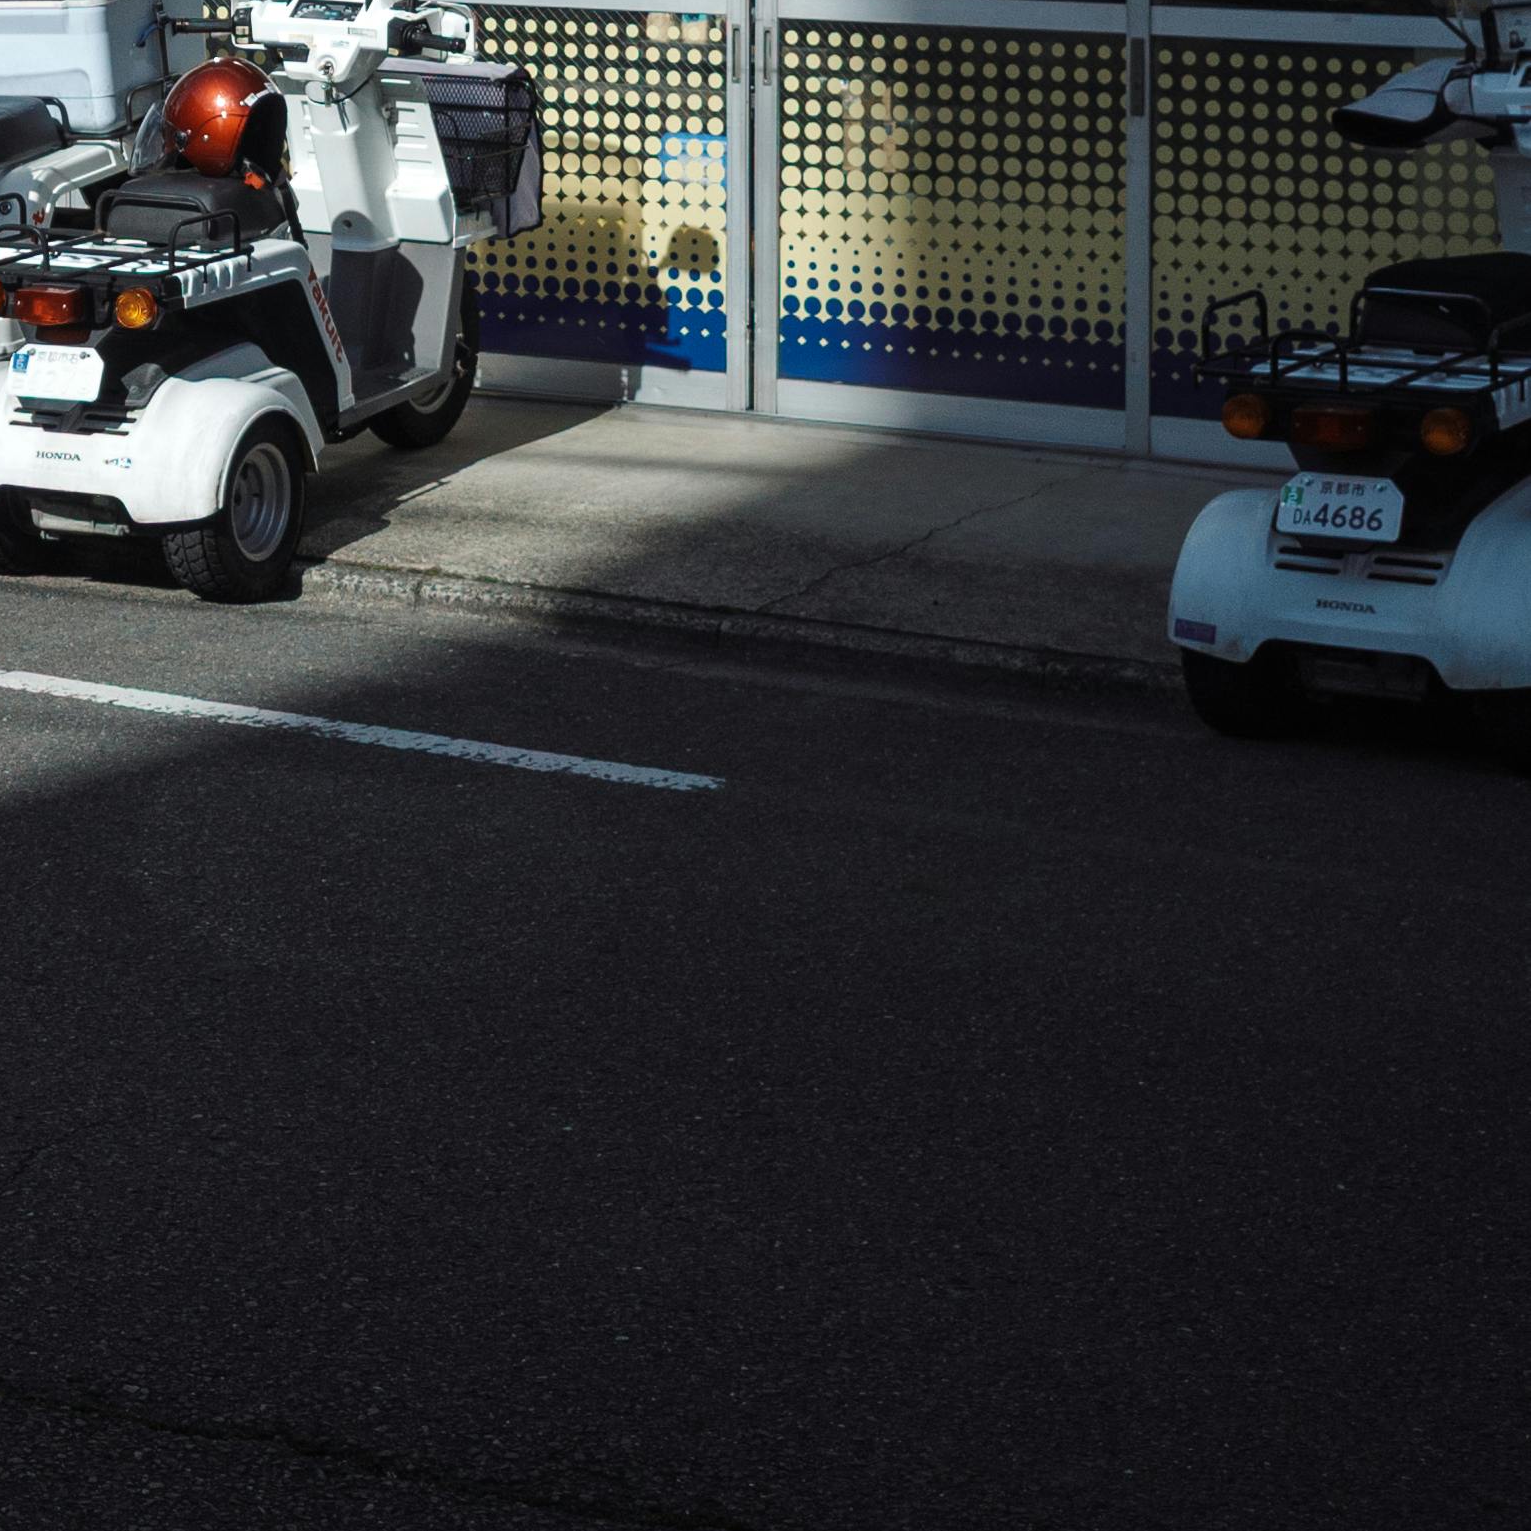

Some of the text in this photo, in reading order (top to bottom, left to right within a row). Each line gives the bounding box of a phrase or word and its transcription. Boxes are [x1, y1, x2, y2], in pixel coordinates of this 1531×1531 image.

[36, 450, 81, 461] HONDA
[1320, 481, 1366, 496] 京都市
[1313, 503, 1383, 531] 4686
[1316, 599, 1376, 614] HONDA
